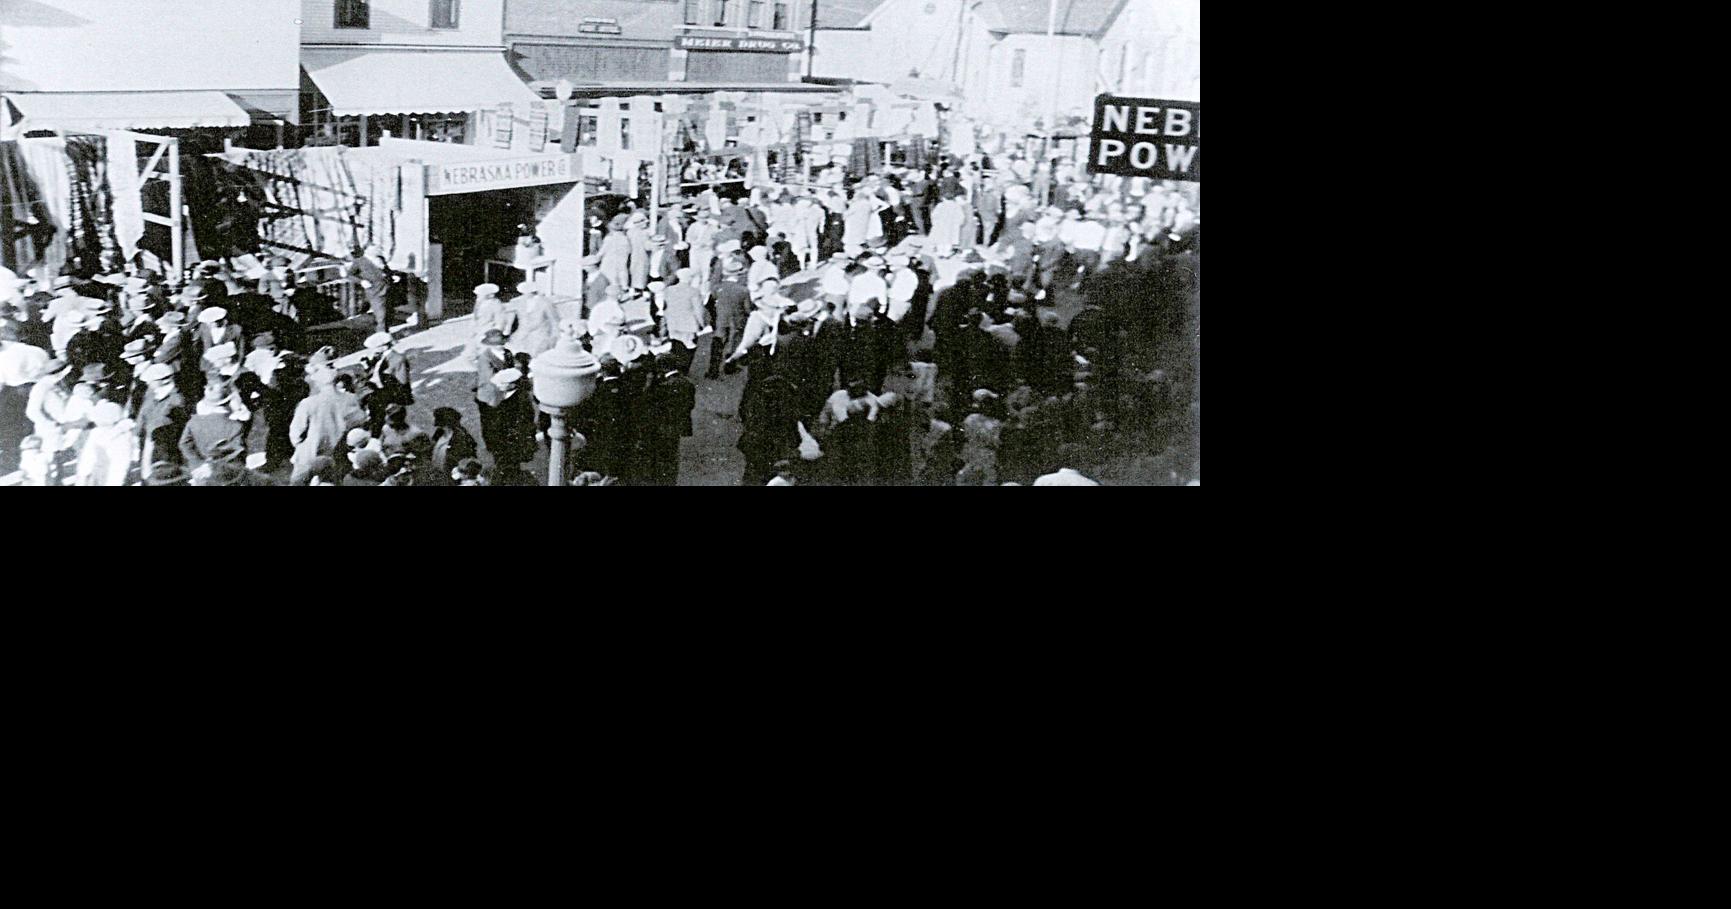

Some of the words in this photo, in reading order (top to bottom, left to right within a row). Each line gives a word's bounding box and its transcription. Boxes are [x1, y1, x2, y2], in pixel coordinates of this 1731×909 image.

[738, 40, 776, 49] DRUG
[1102, 104, 1200, 136] NEB
[443, 164, 511, 185] NEBRASKA
[515, 159, 557, 179] POWER
